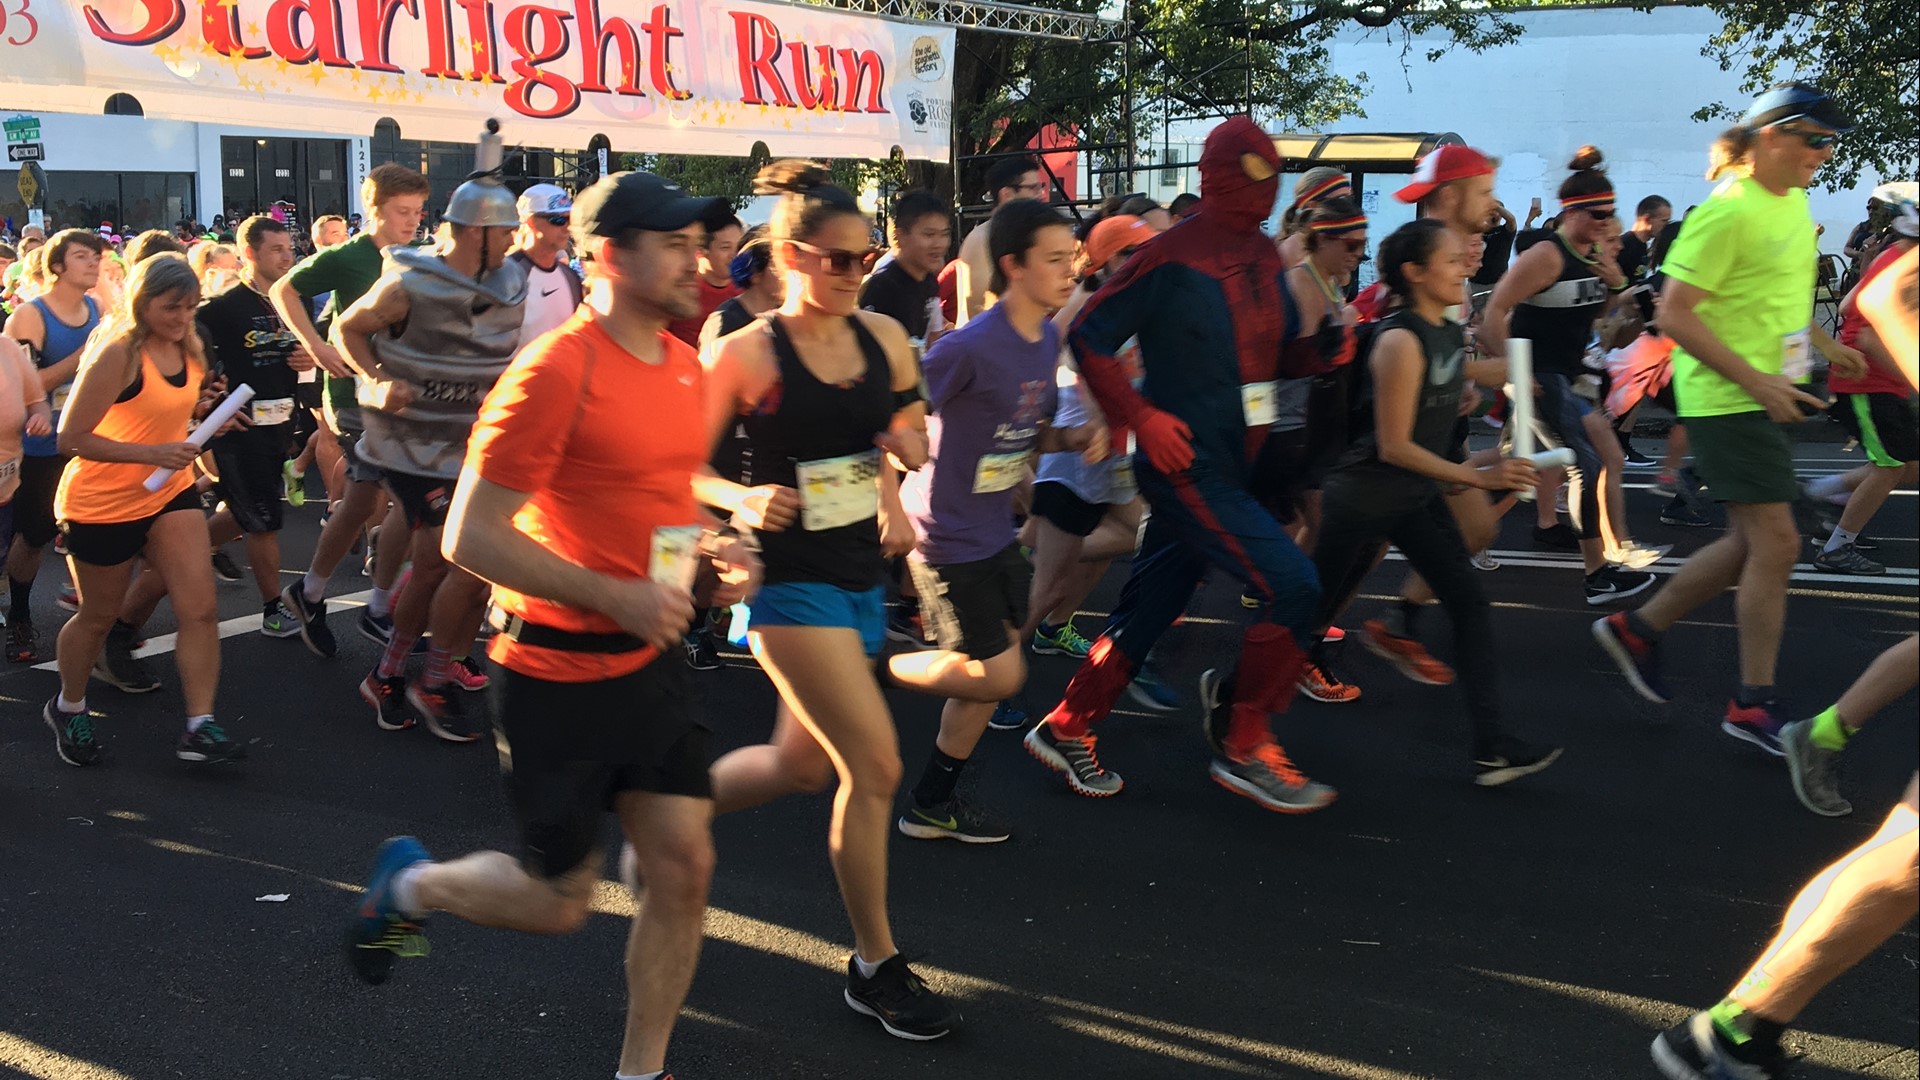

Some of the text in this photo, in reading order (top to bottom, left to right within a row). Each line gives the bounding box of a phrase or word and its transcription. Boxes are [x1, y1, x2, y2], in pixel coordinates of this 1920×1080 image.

[0, 0, 38, 46] 3
[728, 10, 891, 115] Run
[926, 98, 951, 106] PORTL
[928, 105, 951, 121] ROS
[20, 176, 32, 185] DEAD
[22, 188, 32, 198] END
